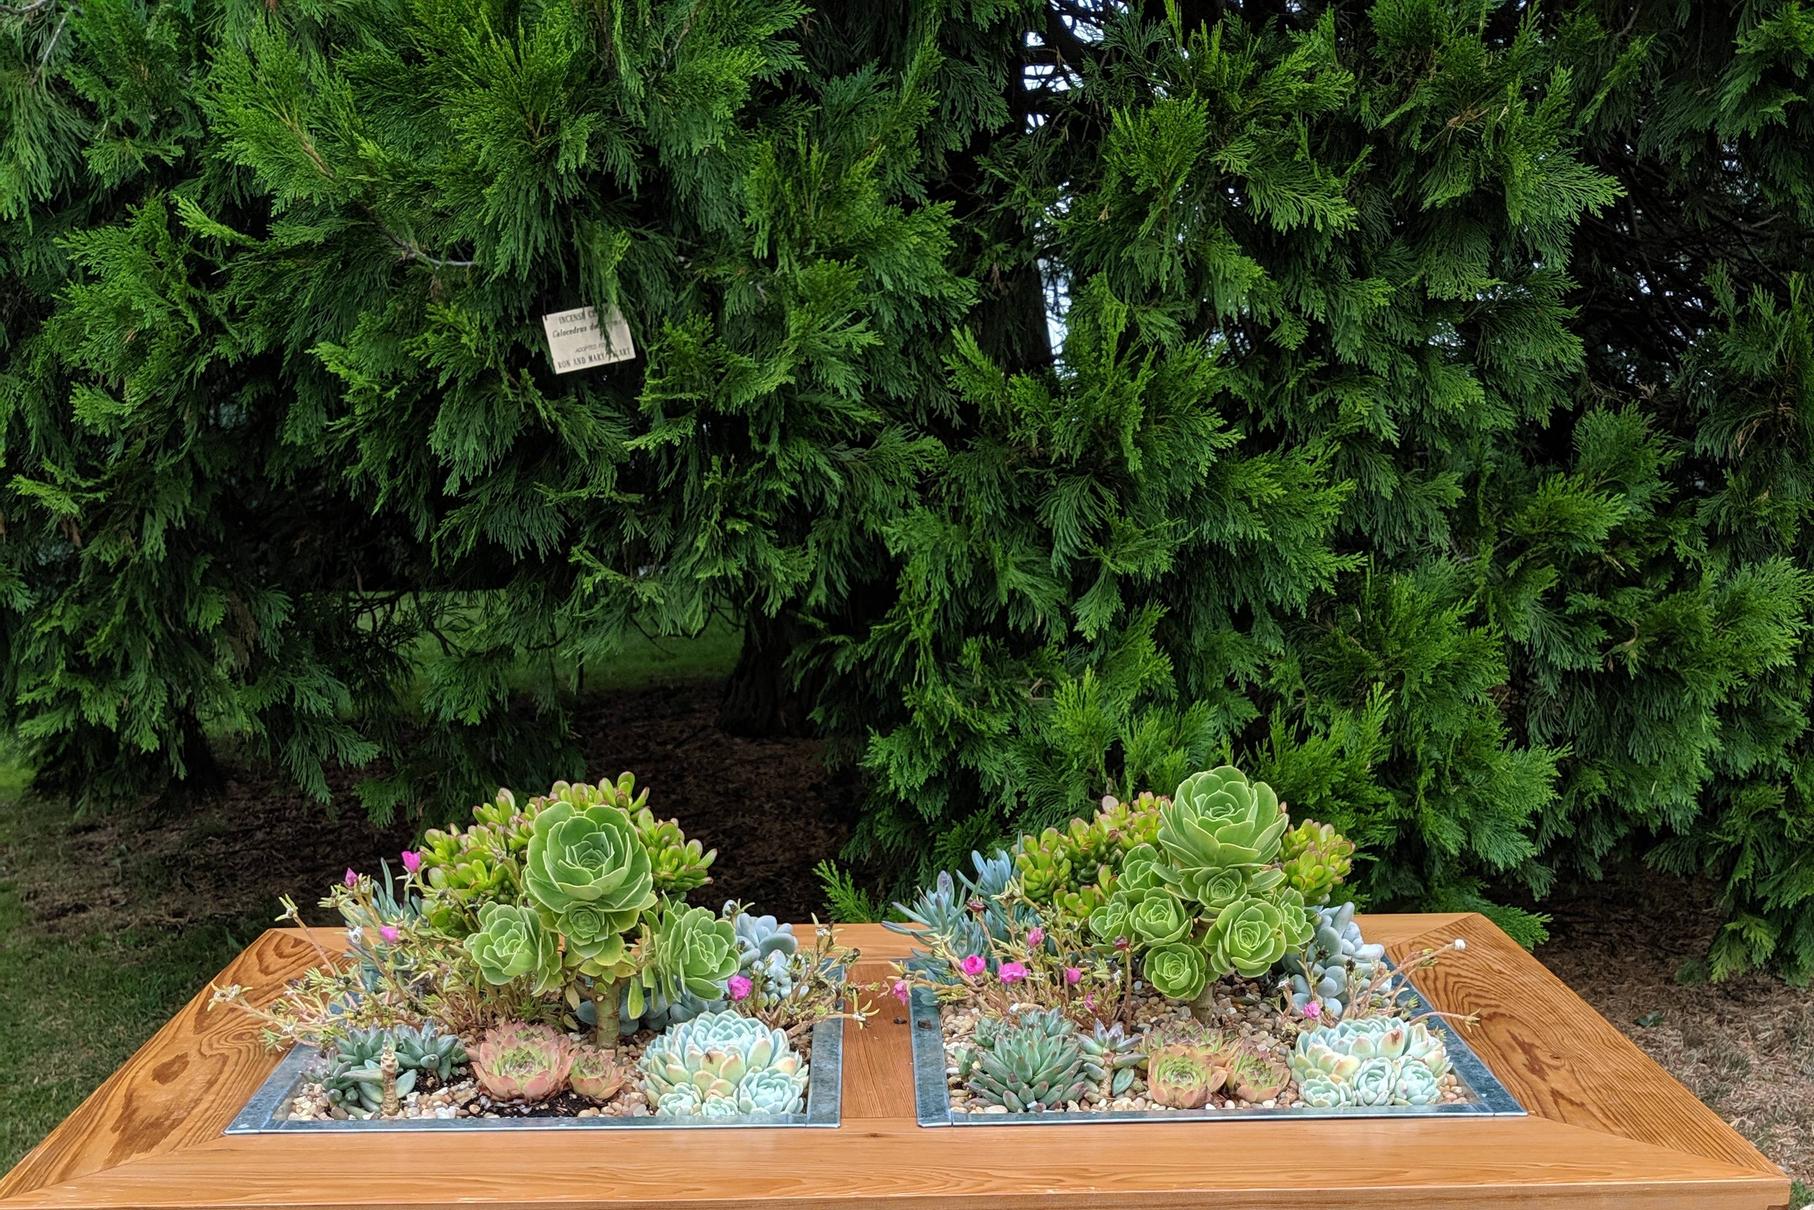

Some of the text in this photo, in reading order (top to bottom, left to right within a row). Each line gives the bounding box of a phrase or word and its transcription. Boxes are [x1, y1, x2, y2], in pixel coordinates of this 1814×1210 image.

[558, 360, 571, 369] RON
[573, 355, 587, 366] AND
[588, 352, 605, 362] MARY
